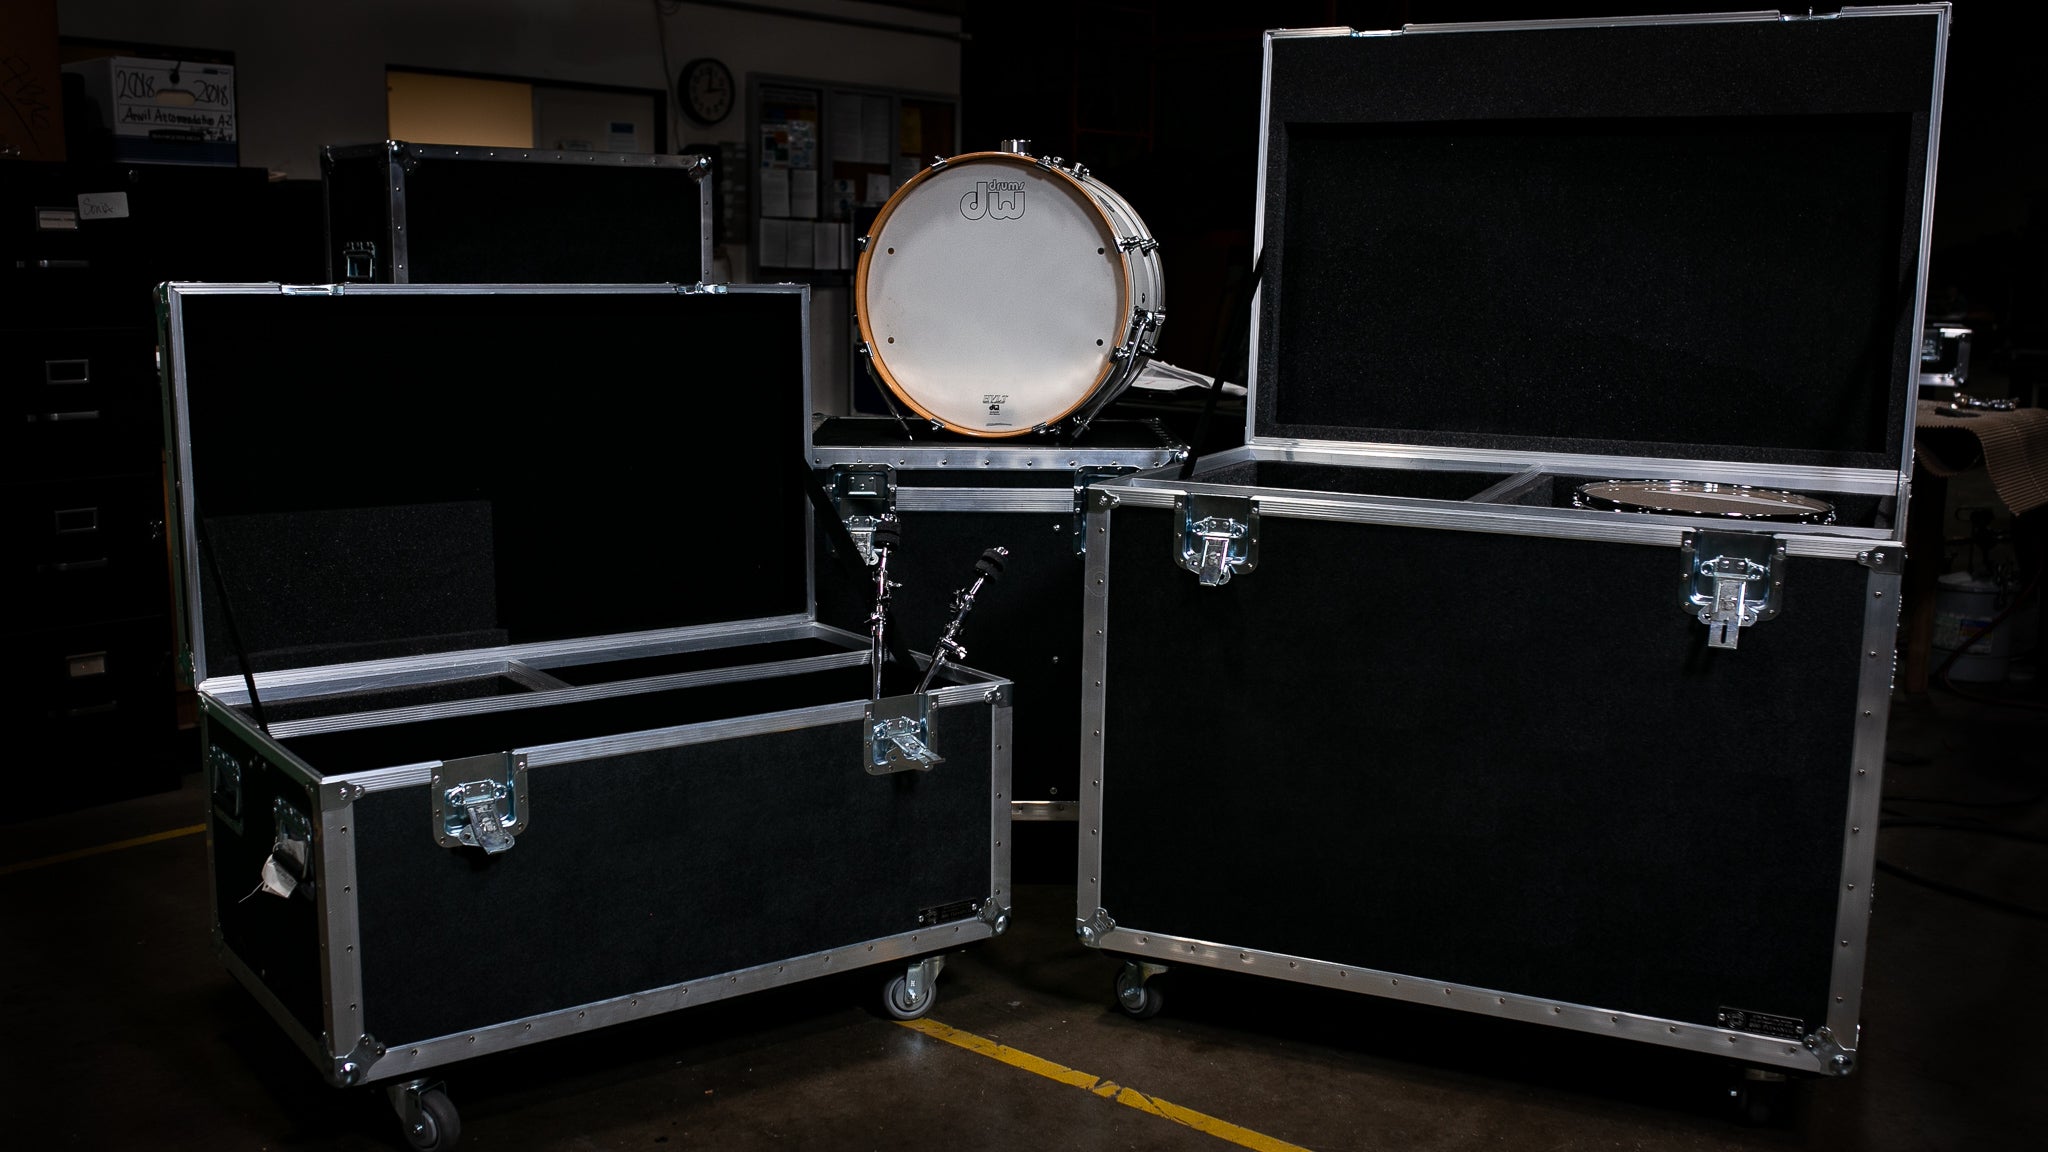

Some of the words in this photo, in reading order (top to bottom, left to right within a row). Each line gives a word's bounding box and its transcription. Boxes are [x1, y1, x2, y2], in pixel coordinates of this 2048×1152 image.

[117, 70, 155, 99] 2018
[193, 79, 229, 106] 2018
[120, 105, 151, 123] Anvil
[988, 179, 1025, 191] drums
[960, 181, 1025, 220] dw
